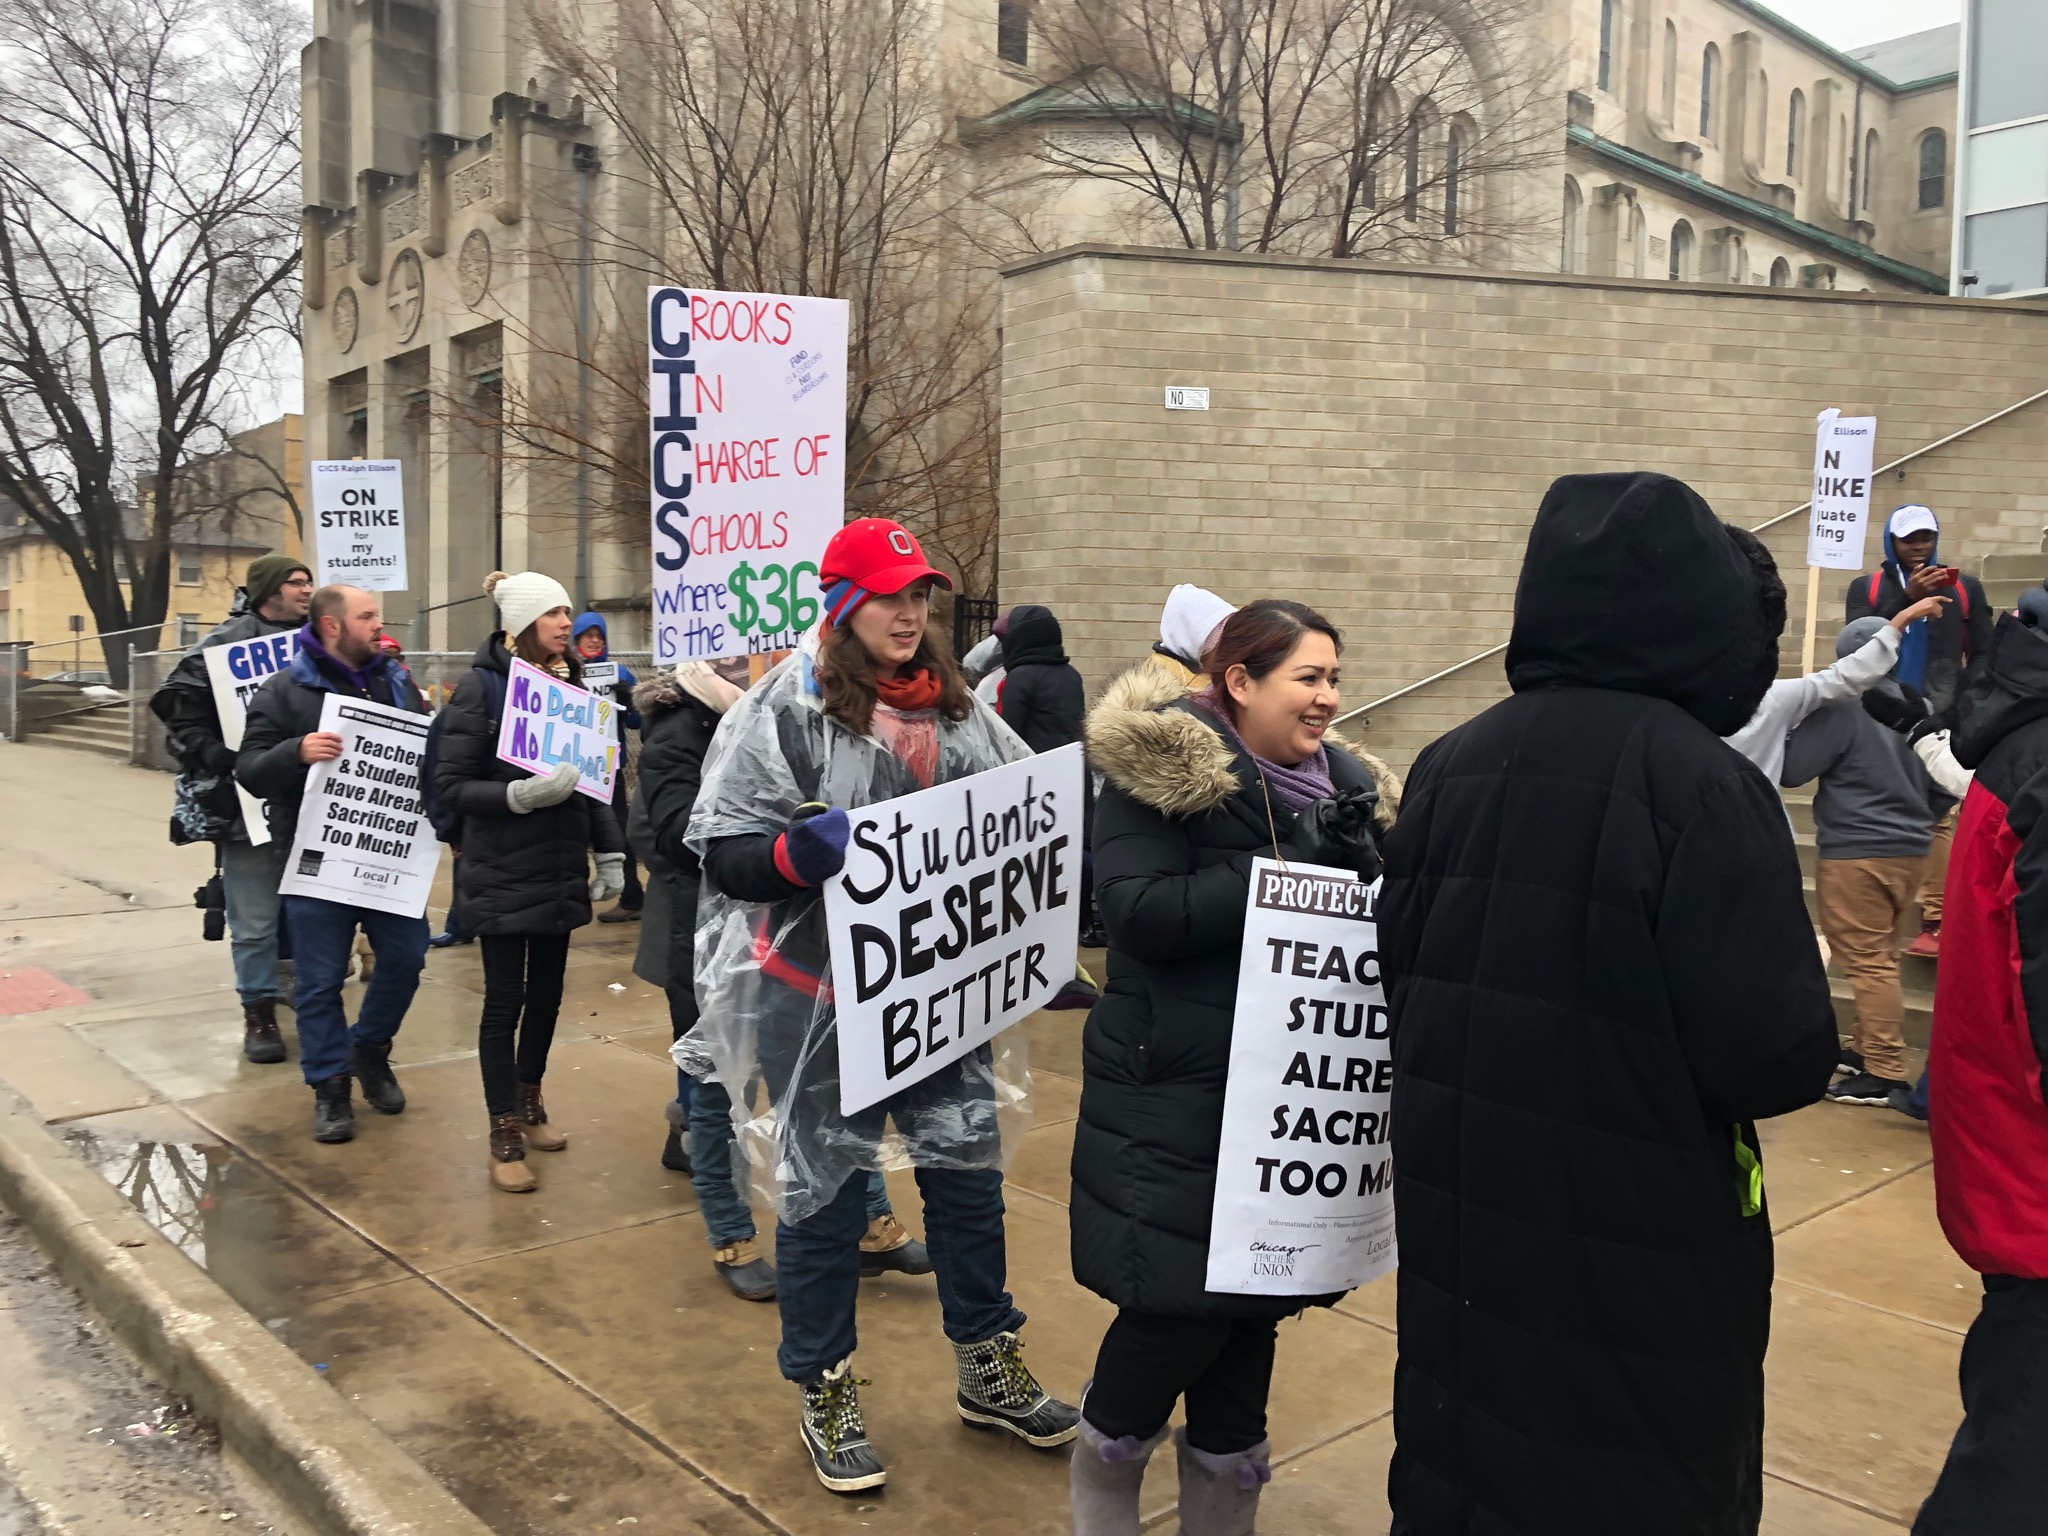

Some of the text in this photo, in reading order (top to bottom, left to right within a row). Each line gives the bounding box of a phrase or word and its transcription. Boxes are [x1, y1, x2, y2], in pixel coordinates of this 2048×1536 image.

[1171, 390, 1183, 405] NO
[1834, 427, 1867, 436] Ellison
[318, 464, 396, 474] CICS Ralph Ellison
[794, 434, 830, 476] OF
[341, 488, 376, 506] ON
[320, 509, 400, 528] STRIKE
[1817, 509, 1857, 522] uate
[352, 544, 373, 555] my
[354, 532, 369, 540] for
[887, 529, 914, 556] O
[327, 555, 397, 568] students!
[653, 560, 818, 636] where $36
[658, 617, 725, 658] is the
[748, 630, 804, 654] MILLI
[512, 675, 611, 734] No Deal?
[511, 717, 538, 760] No
[339, 759, 420, 791] & Studen
[323, 777, 428, 818] Have Alread
[327, 802, 419, 837] Sacrificed
[321, 825, 412, 859] Too Much!
[841, 775, 1056, 904] Students
[353, 866, 399, 885] Local 1
[1262, 874, 1379, 917] PROTECT
[850, 835, 1069, 1004] DESERVE
[1266, 937, 1380, 986] TEAC
[883, 942, 1049, 1080] BETTER
[1286, 996, 1390, 1040] STUD
[1282, 1051, 1393, 1093] ALRE
[1270, 1104, 1392, 1146] SACRI
[1255, 1157, 1347, 1198] TOO
[1268, 1219, 1312, 1229] Informational
[1313, 1222, 1327, 1230] Only
[1249, 1241, 1321, 1257] Chicago
[1254, 1252, 1296, 1264] TEACHERS
[1367, 1231, 1392, 1255] Local
[1253, 1263, 1294, 1277] UNION
